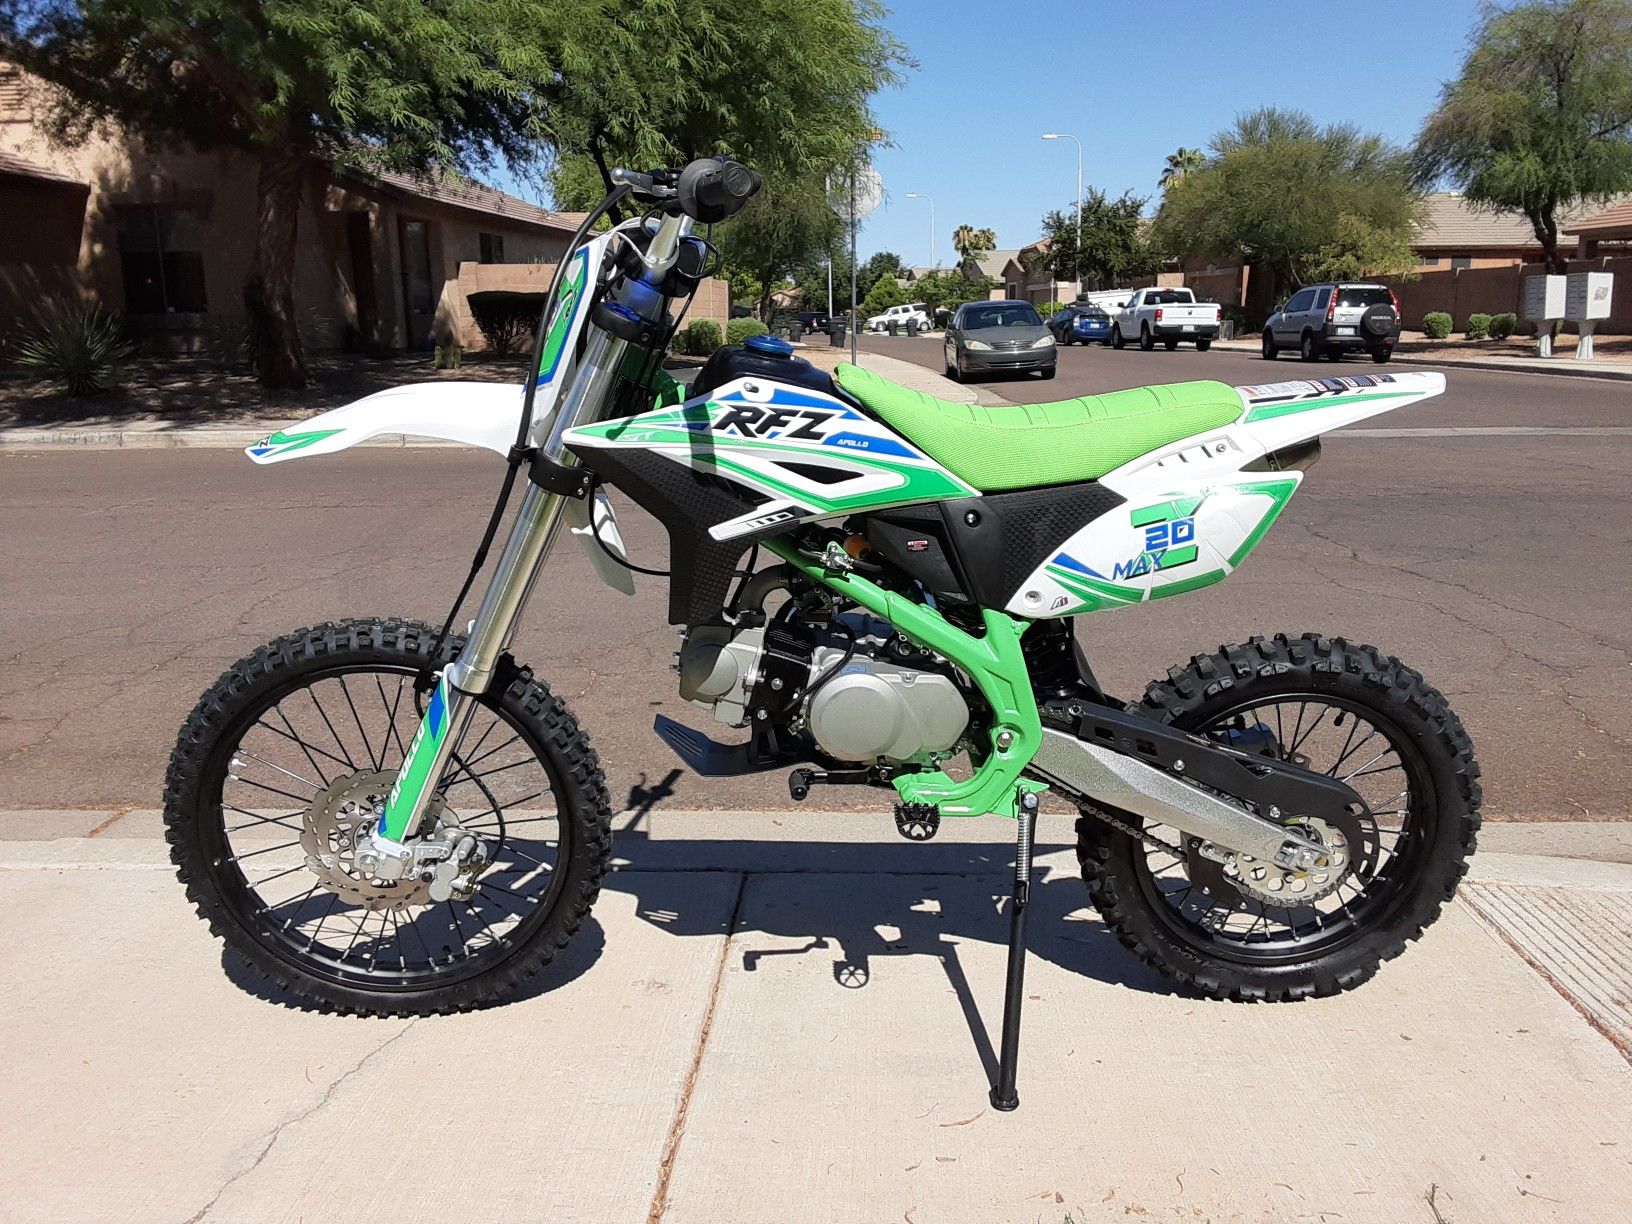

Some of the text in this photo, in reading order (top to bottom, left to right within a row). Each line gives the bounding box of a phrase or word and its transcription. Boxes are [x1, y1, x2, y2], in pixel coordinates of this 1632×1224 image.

[712, 405, 836, 440] RFZ
[837, 439, 869, 447] APOLLO
[1112, 549, 1167, 581] MAX
[390, 720, 425, 810] APOLLO
